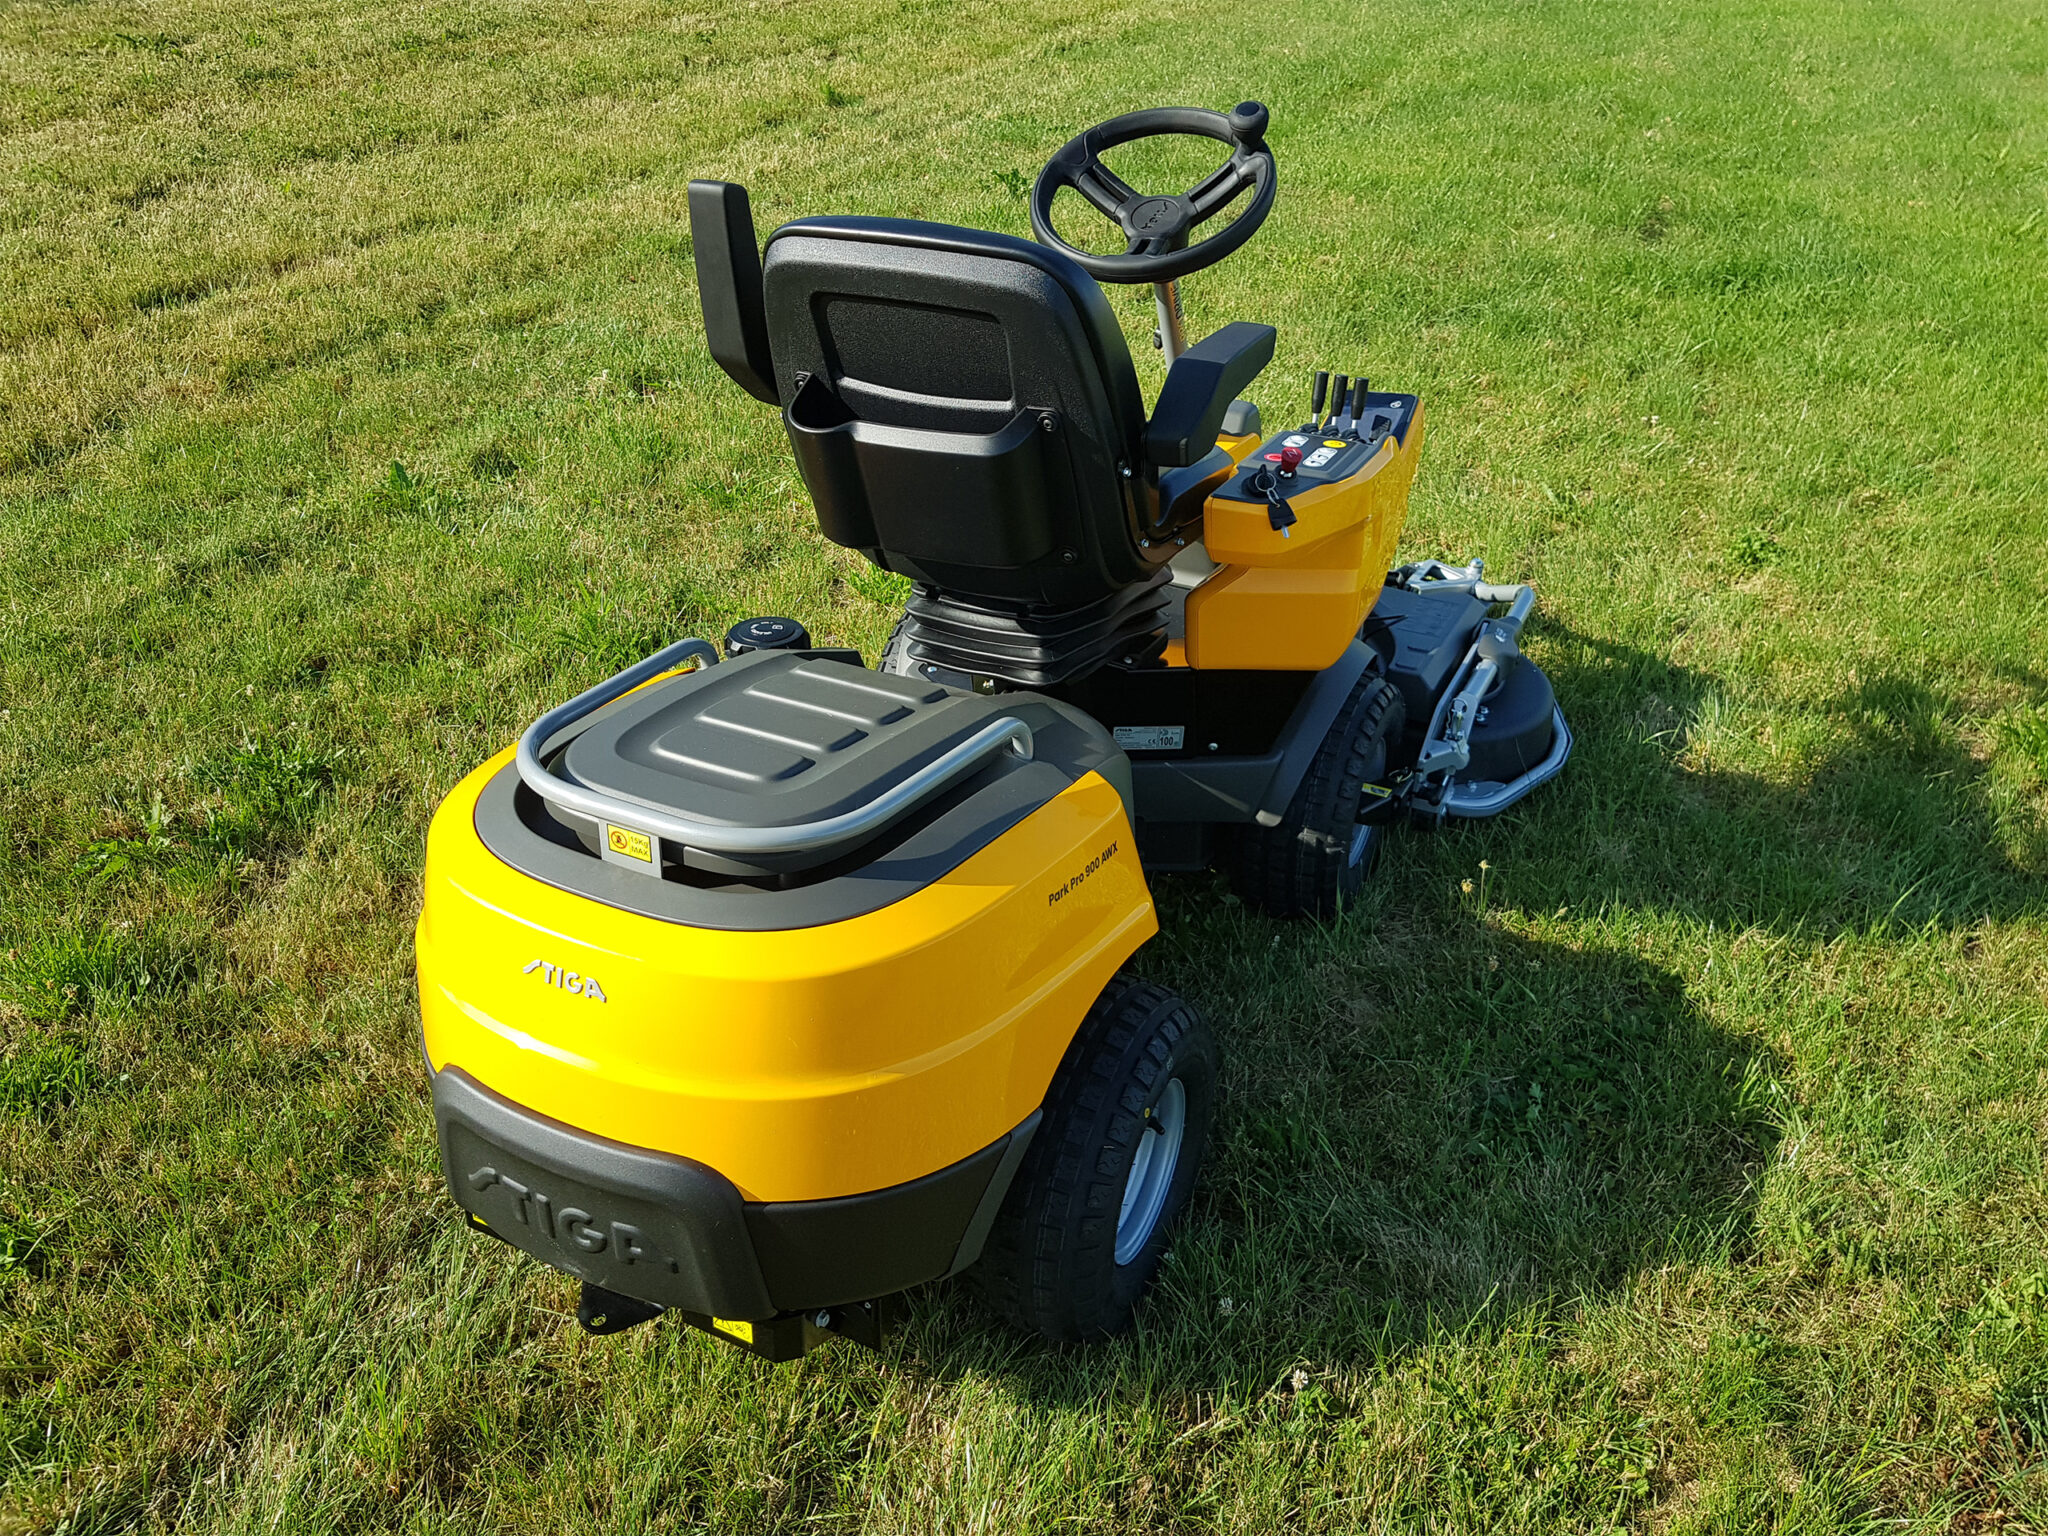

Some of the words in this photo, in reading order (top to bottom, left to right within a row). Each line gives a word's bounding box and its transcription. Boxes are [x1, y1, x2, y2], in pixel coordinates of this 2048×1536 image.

[1160, 736, 1174, 746] 100
[1048, 883, 1069, 907] Park
[1070, 873, 1085, 890] Pro
[1085, 857, 1100, 877] 900
[1101, 840, 1118, 864] AWX
[523, 959, 607, 1003] STIGA
[468, 1167, 679, 1274] STIGA
